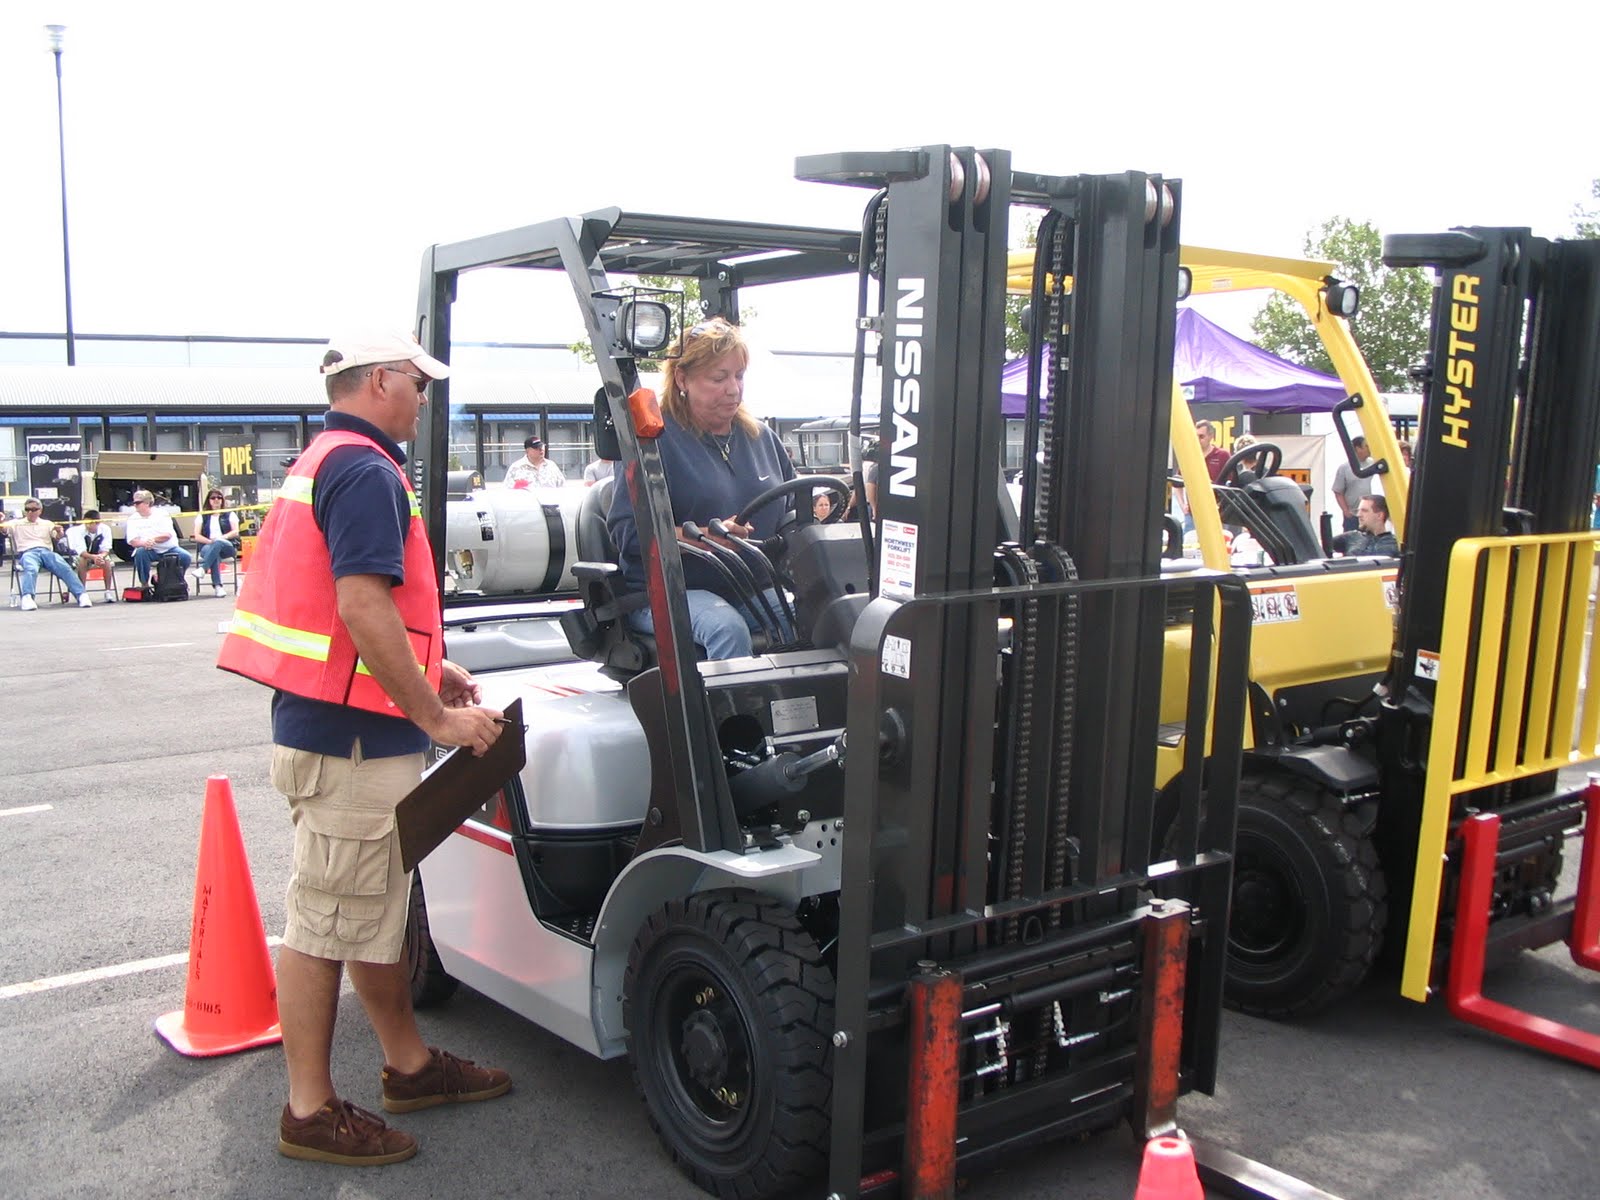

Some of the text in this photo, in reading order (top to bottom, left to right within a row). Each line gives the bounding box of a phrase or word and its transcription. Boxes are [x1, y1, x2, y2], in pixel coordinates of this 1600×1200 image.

[889, 278, 925, 497] NISSAN
[1441, 274, 1480, 449] HYSTER
[30, 443, 80, 452] DOOSAN
[884, 538, 915, 548] NORTHWEST
[887, 545, 911, 553] FORKLIFT
[195, 885, 211, 980] MATERIALS
